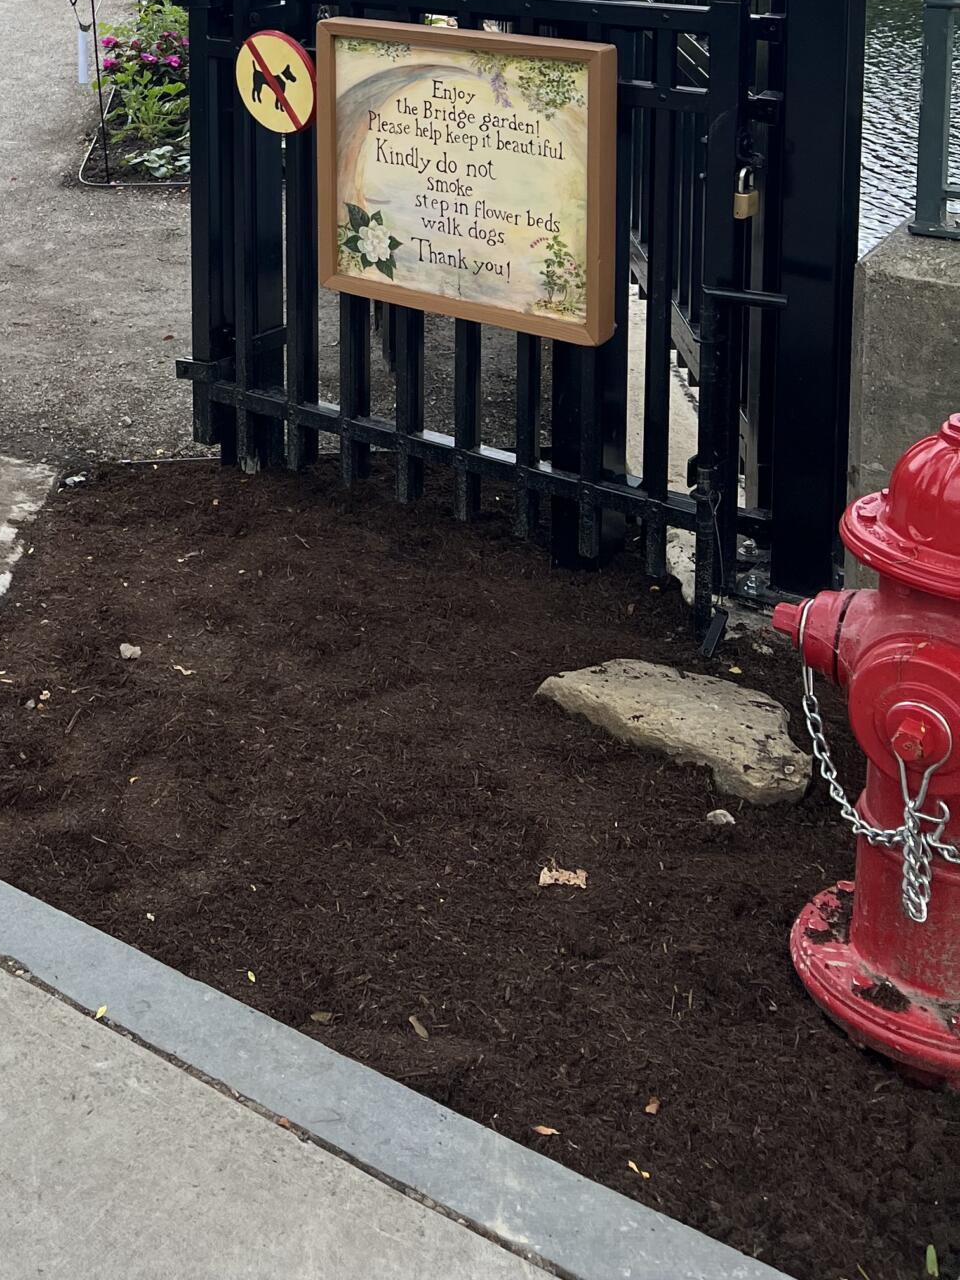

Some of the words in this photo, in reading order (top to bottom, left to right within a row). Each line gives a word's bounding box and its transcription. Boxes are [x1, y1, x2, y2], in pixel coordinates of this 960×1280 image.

[432, 79, 476, 104] Enjoy
[368, 110, 411, 135] Please
[415, 119, 442, 146] help
[446, 125, 478, 151] keep
[482, 130, 492, 147] it
[396, 98, 419, 116] the
[423, 100, 476, 128] Bridge
[479, 113, 540, 137] garden!
[376, 139, 431, 174] Kindly
[436, 152, 458, 174] do
[466, 159, 496, 180] not
[426, 177, 473, 197] smoke
[415, 194, 449, 217] step
[454, 199, 469, 216] in
[475, 200, 521, 225] flower
[526, 210, 560, 233] beds
[421, 216, 461, 237] walk
[411, 237, 469, 270] Thank
[473, 260, 511, 283] you!
